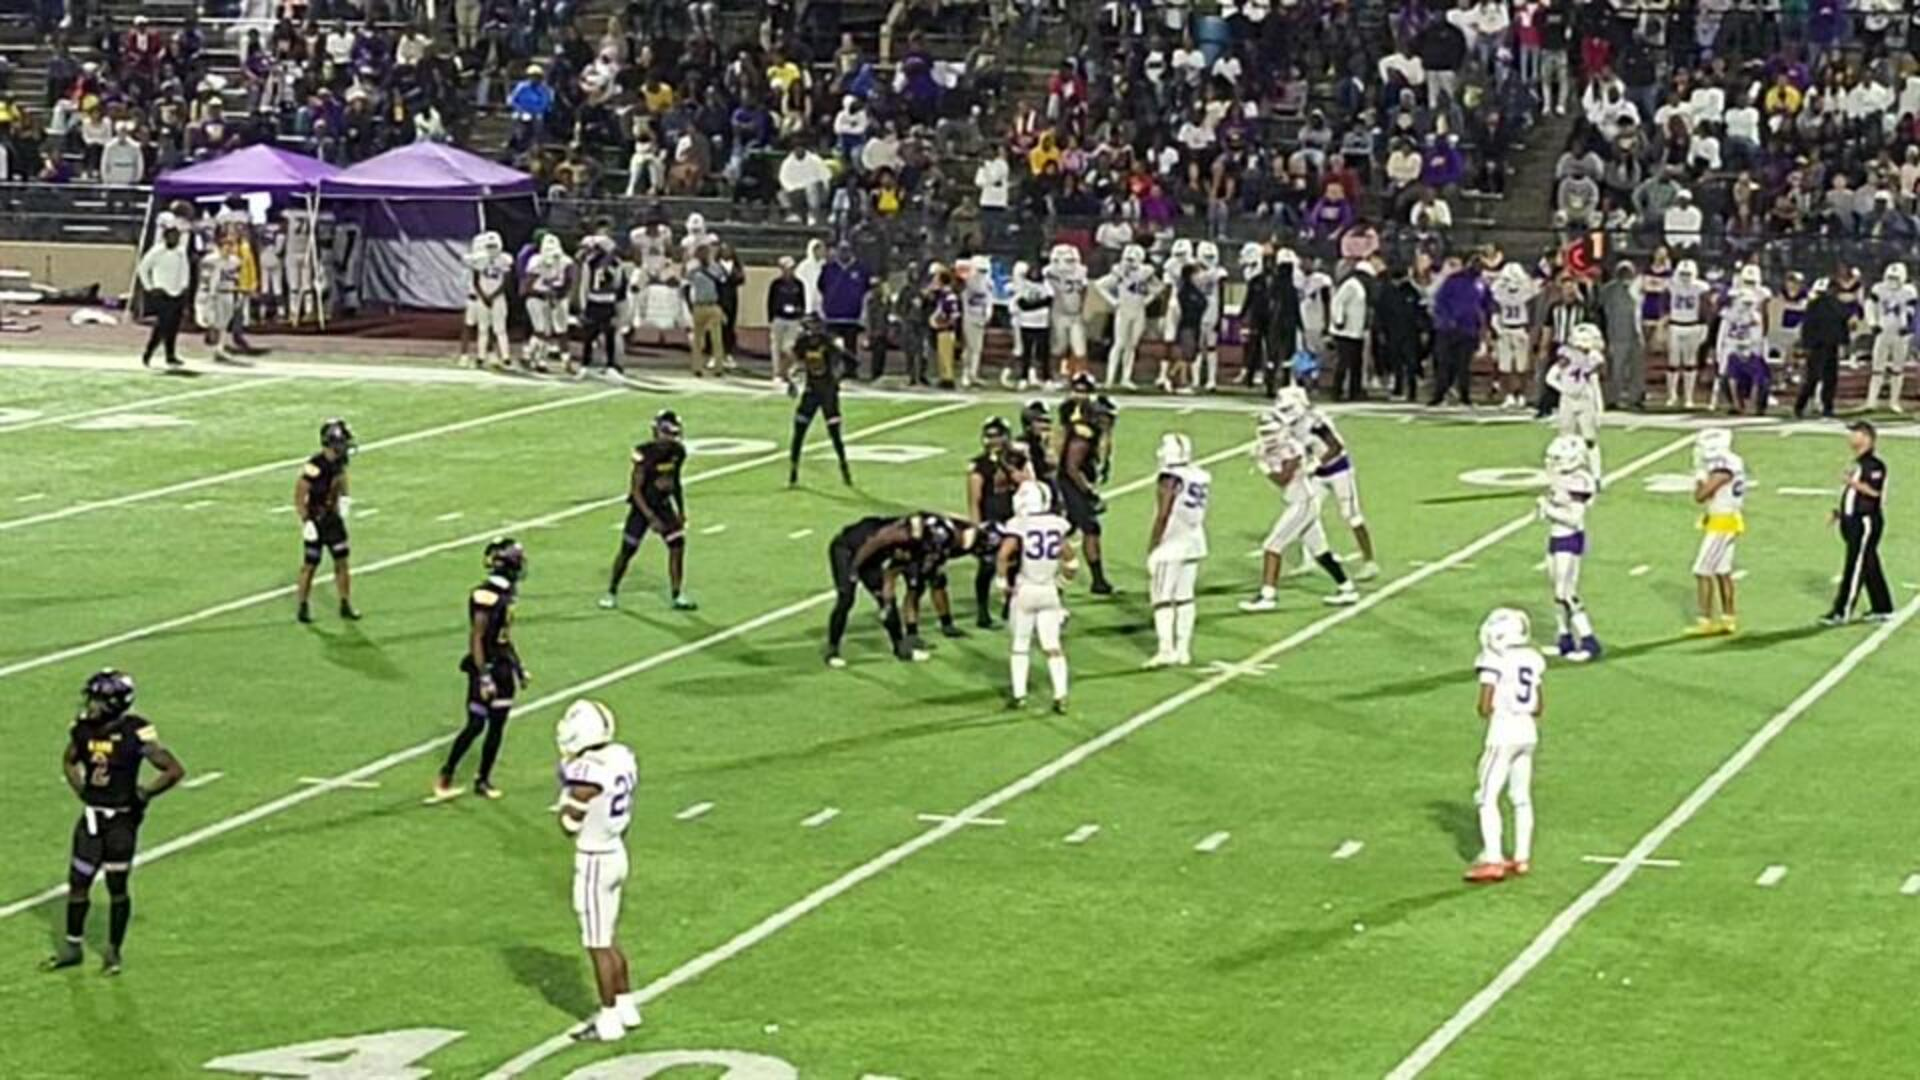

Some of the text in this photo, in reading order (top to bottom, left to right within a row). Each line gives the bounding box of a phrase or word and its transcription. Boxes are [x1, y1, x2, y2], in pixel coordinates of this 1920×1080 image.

[1025, 530, 1064, 560] 32
[1516, 666, 1533, 704] 5
[89, 752, 111, 787] 2
